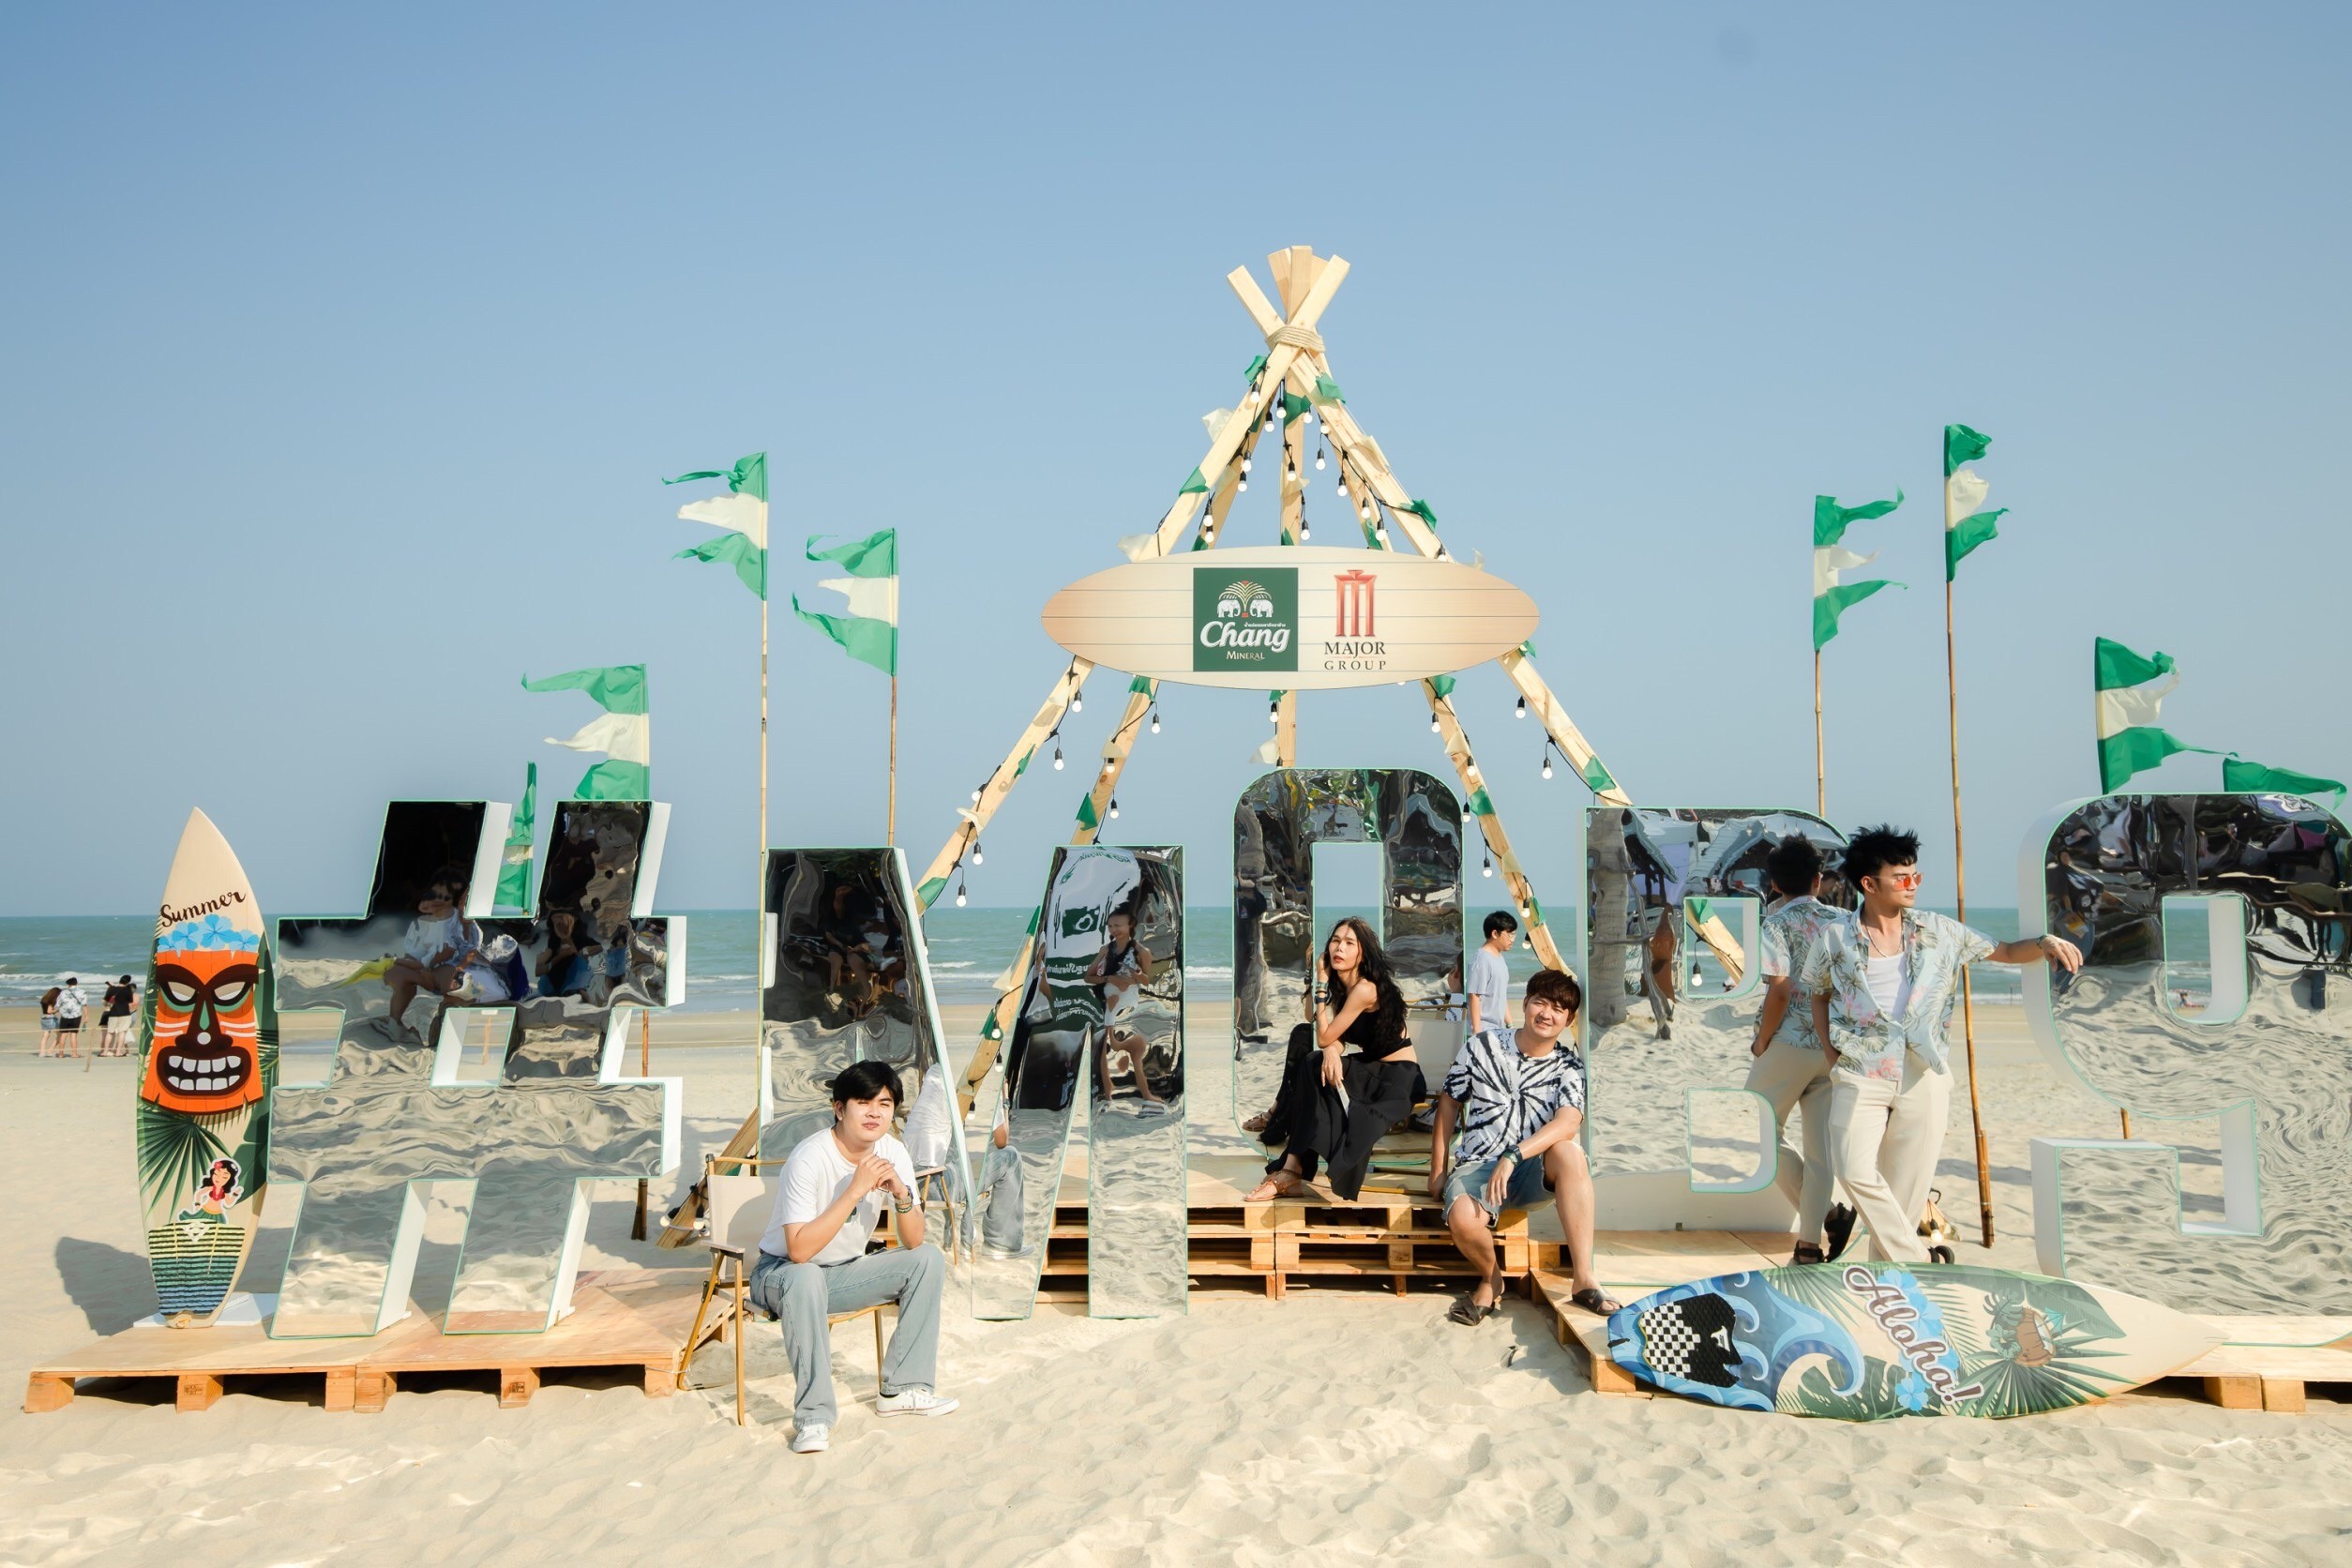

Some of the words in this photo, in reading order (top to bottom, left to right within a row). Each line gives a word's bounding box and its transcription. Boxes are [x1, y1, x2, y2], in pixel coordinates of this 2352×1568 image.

[1200, 621, 1290, 653] Chang
[1226, 651, 1265, 661] MINERAL
[1324, 641, 1386, 658] MAJOR
[1324, 660, 1386, 671] GROUP
[160, 891, 247, 927] Summer
[1844, 1266, 1983, 1404] Aloha!
